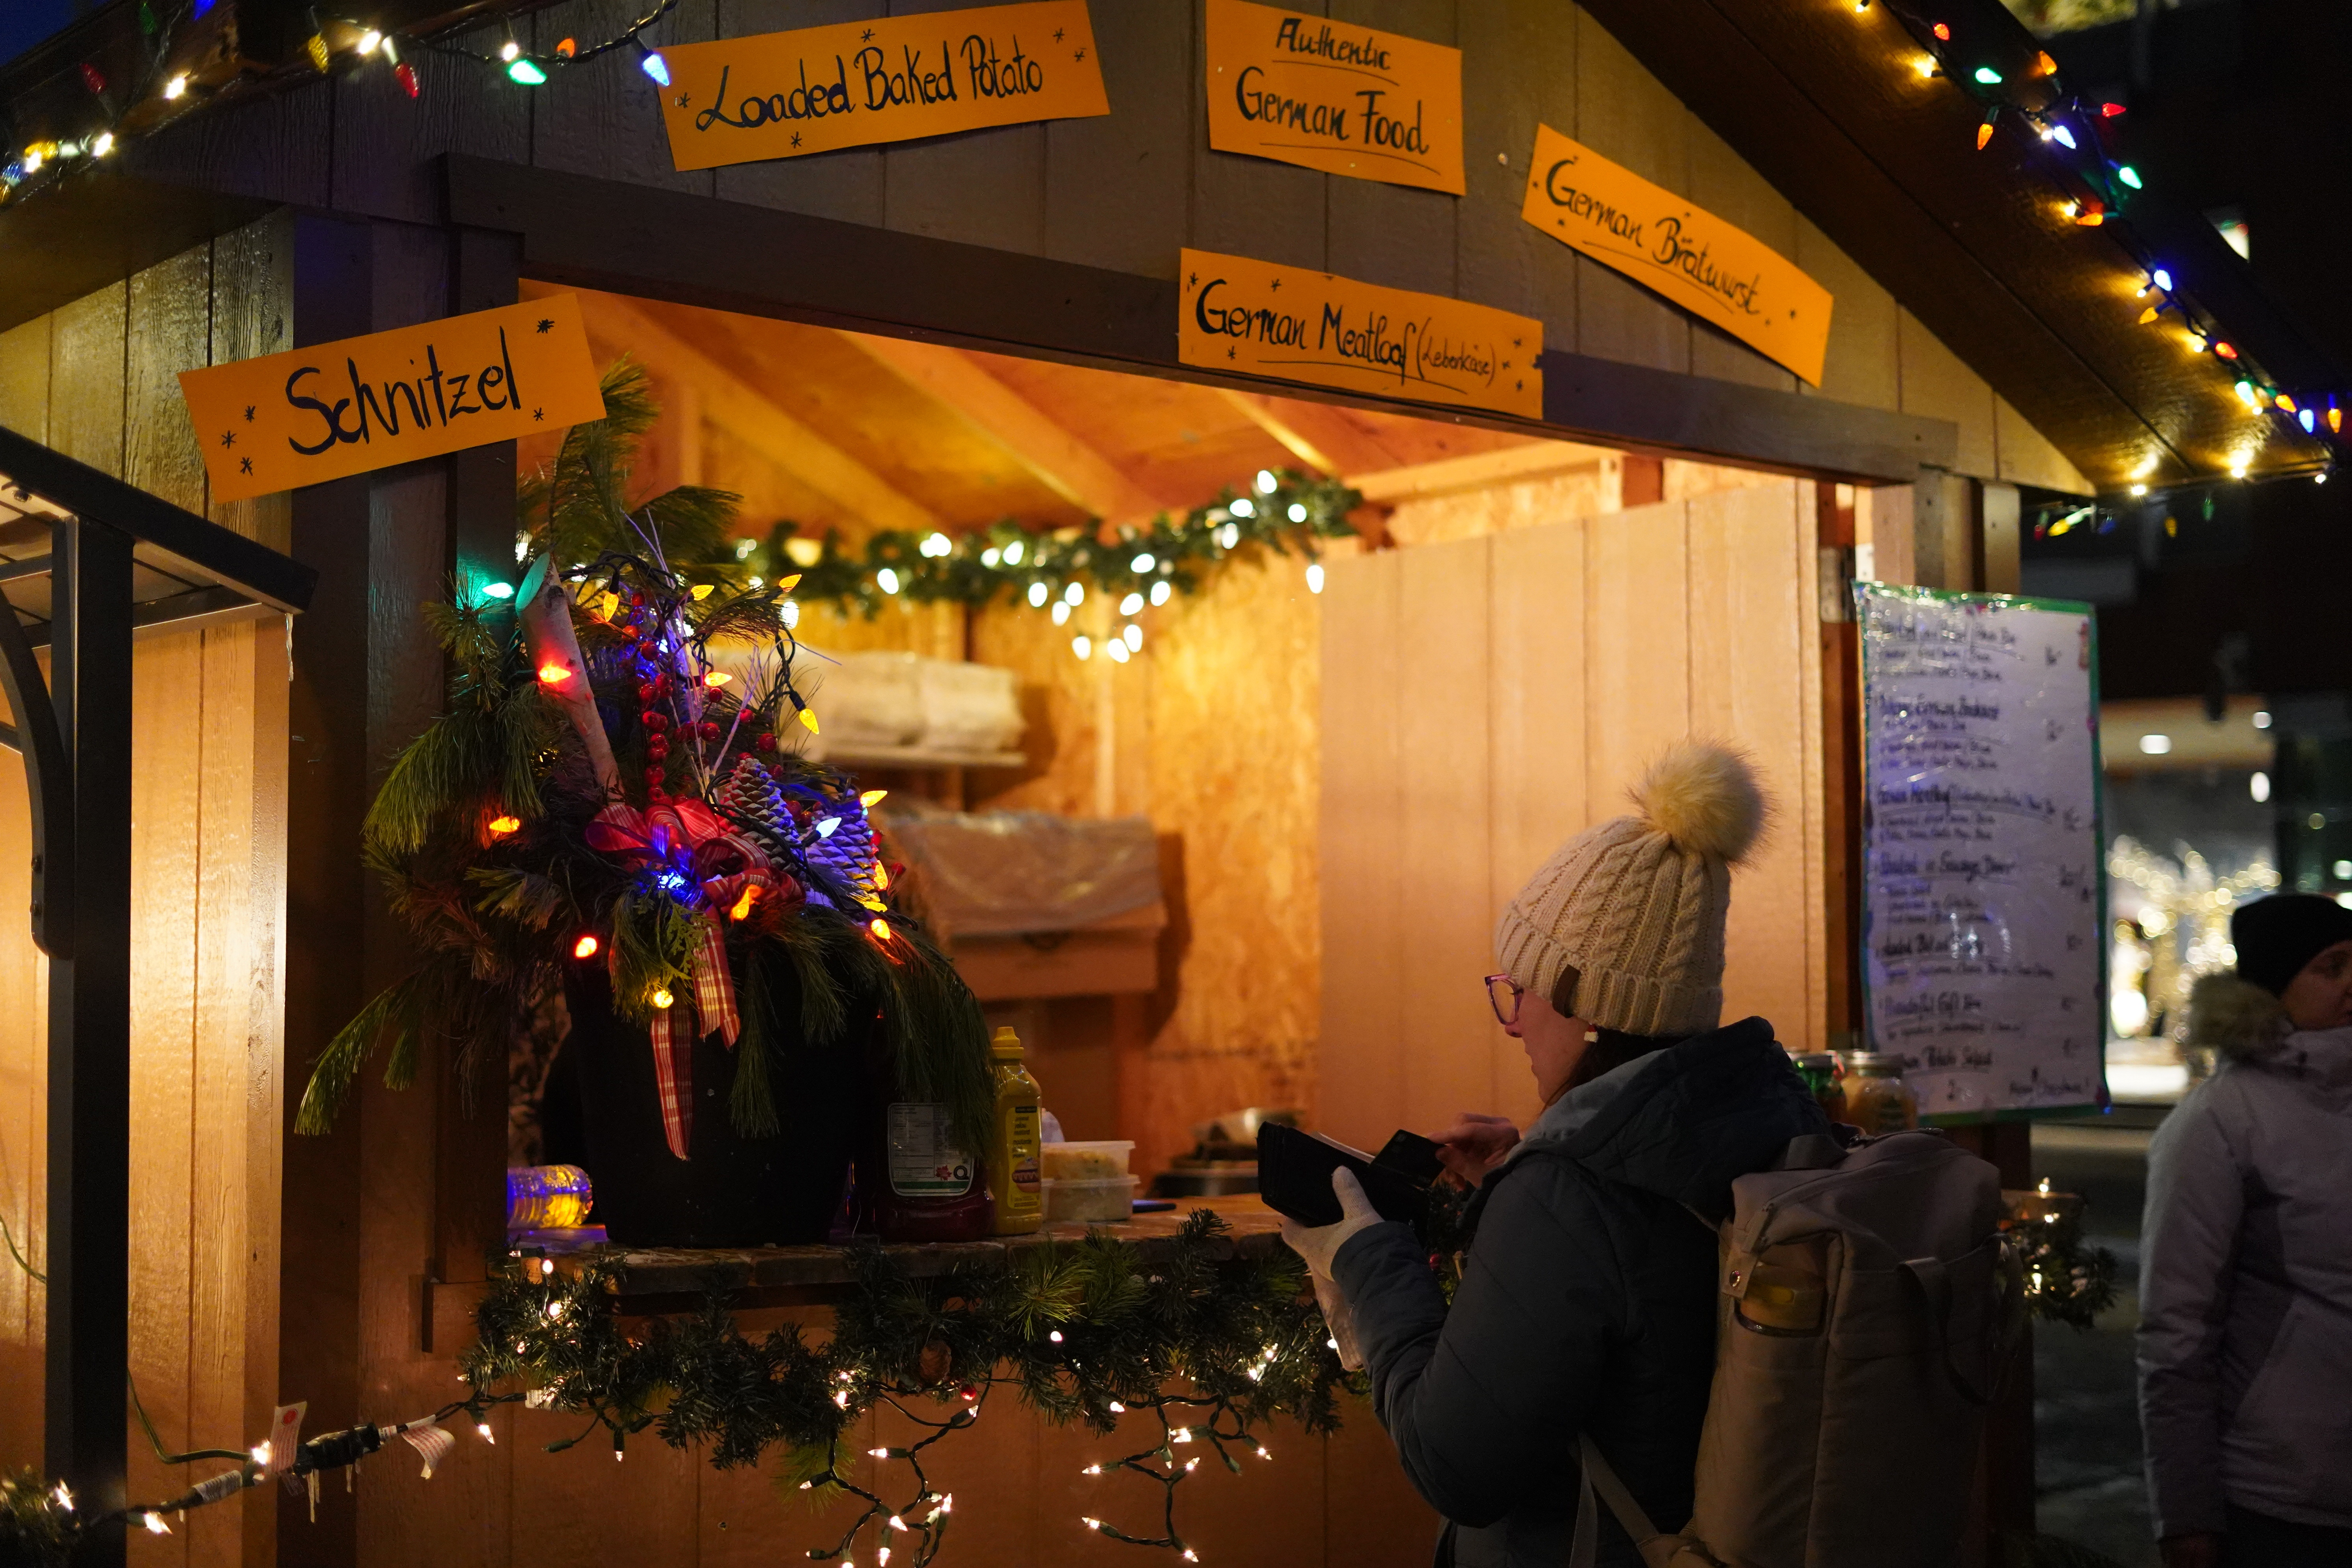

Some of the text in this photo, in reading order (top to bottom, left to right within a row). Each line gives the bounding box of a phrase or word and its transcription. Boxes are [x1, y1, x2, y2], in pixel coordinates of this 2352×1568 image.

[695, 34, 1043, 132] Loaded Baked Potato
[1276, 17, 1391, 70] Authentic
[1236, 66, 1429, 155] German Food
[1546, 159, 1642, 248] German
[1196, 279, 1307, 350] German
[1318, 302, 1417, 386] Meatloaf
[285, 326, 521, 456] Schnitzel
